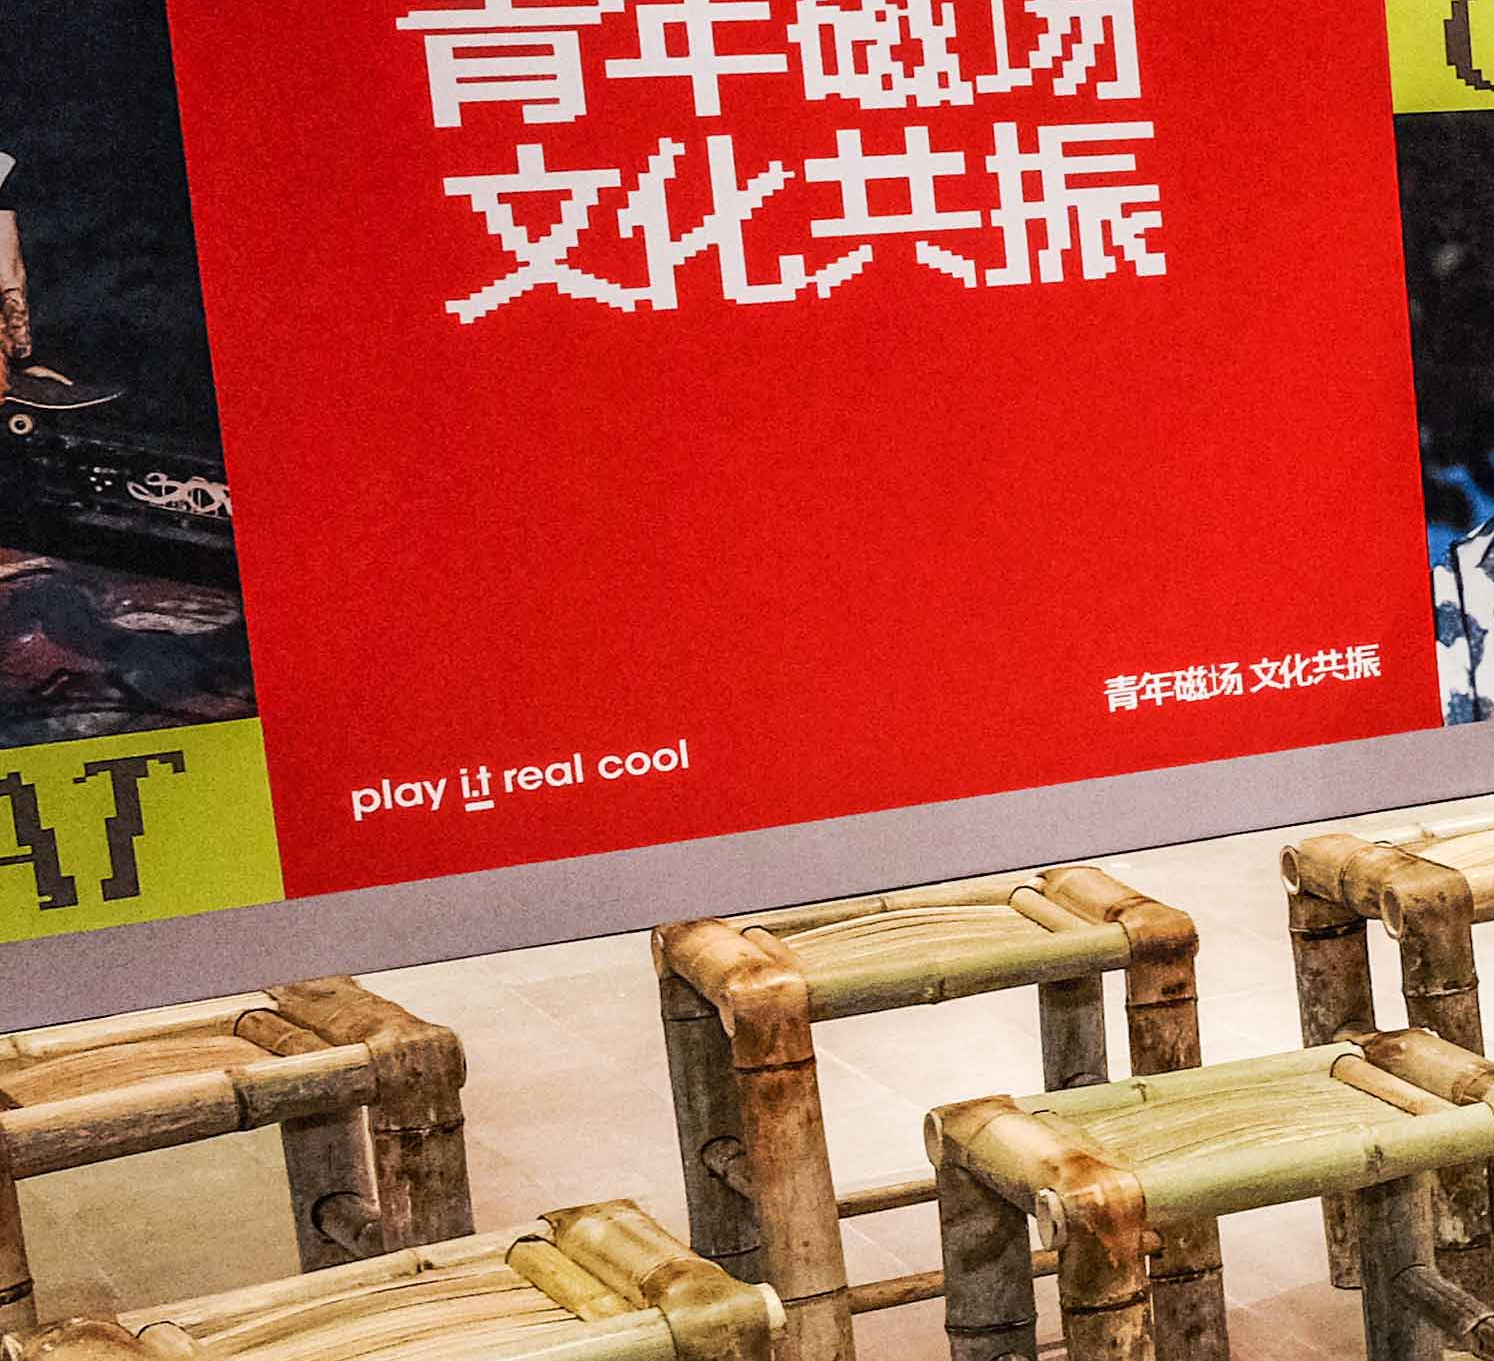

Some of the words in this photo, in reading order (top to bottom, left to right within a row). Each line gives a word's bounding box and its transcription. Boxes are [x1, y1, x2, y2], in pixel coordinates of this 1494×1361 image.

[444, 121, 1167, 325] 文化共振
[1104, 659, 1244, 712] 青年磁场
[1249, 643, 1383, 694] 文化共振
[351, 772, 446, 824] play
[502, 752, 584, 793] real
[597, 738, 690, 784] cool
